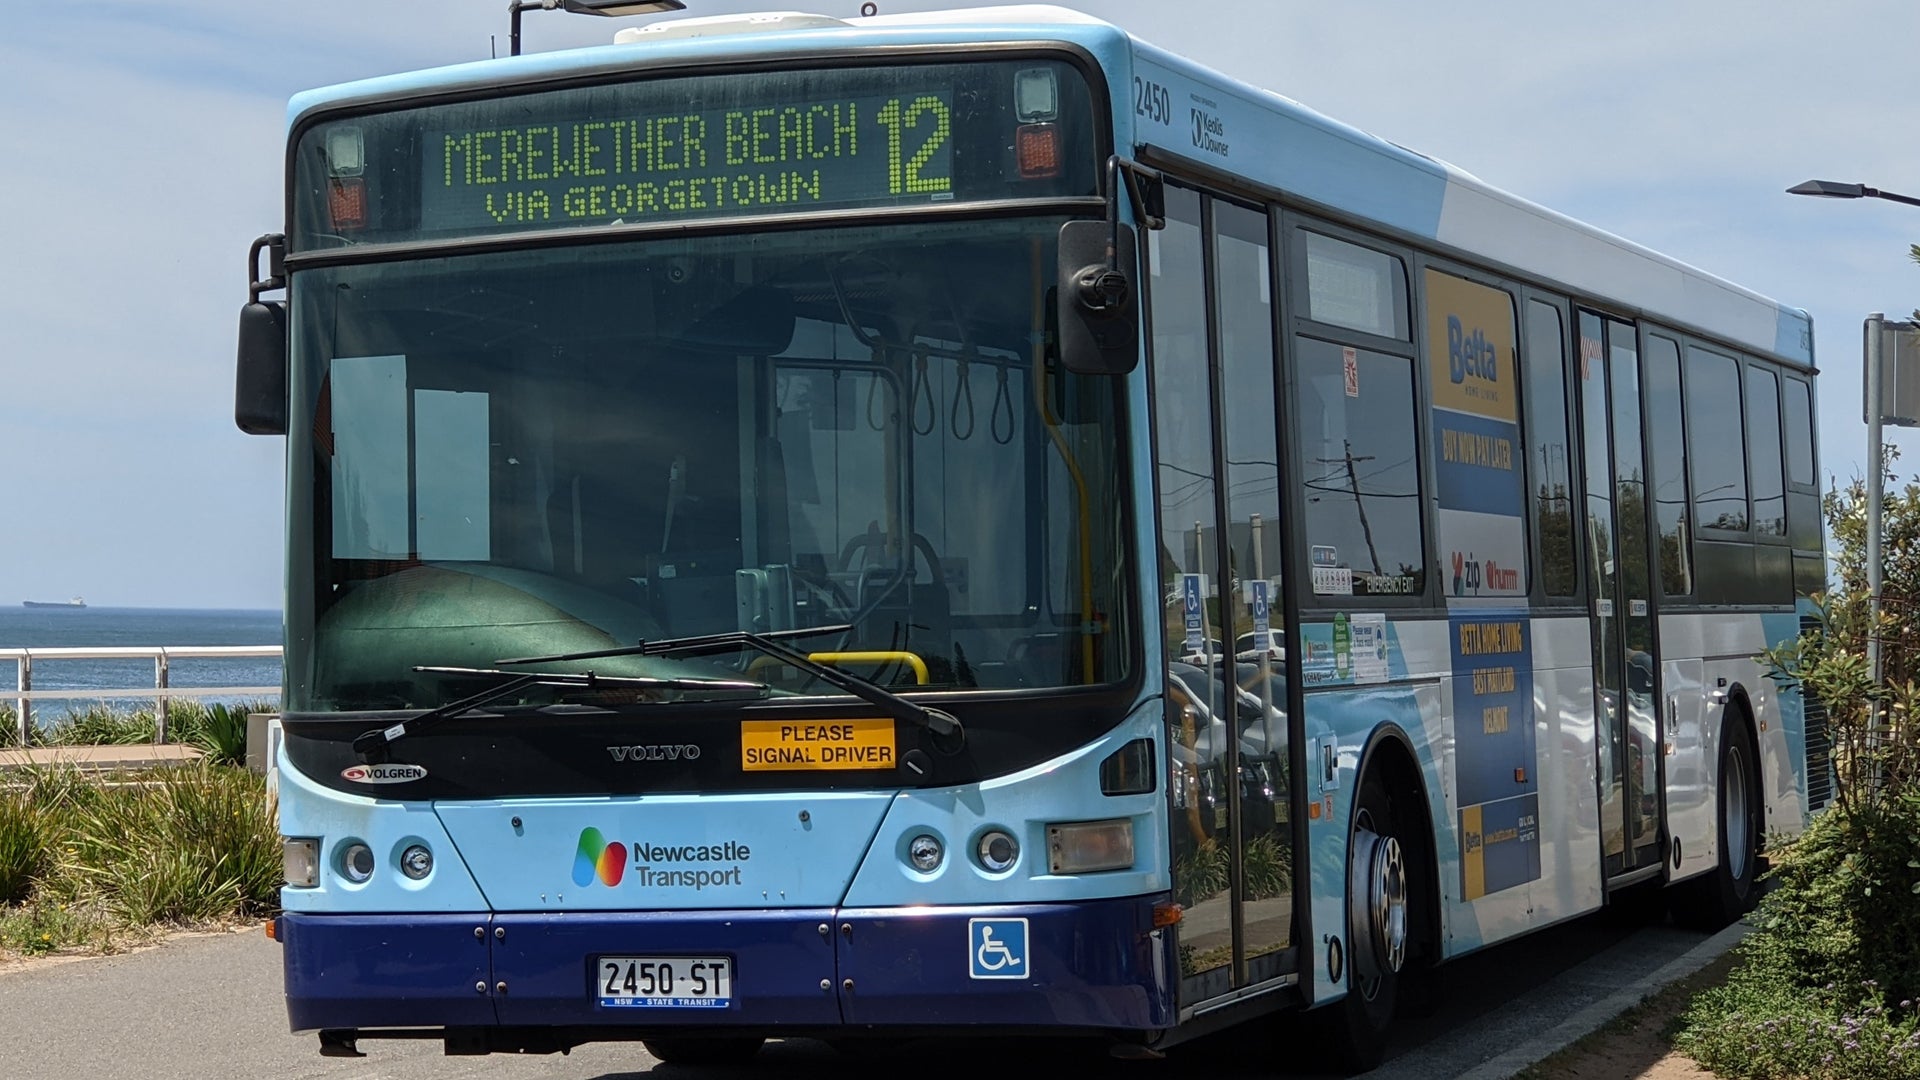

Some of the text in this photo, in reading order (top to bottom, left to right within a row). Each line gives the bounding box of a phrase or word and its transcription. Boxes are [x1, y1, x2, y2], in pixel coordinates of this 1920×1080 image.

[1135, 76, 1170, 126] 2450
[1203, 112, 1223, 137] Keolis
[444, 102, 857, 186] MEREWETHER BEACH
[877, 96, 951, 194] 12
[1204, 133, 1229, 157] Downer
[486, 170, 820, 222] VIA GEORGETOWN
[1447, 314, 1497, 384] Betta
[1442, 428, 1512, 470] BUY NOW PAY LATER
[1367, 576, 1402, 593] EMERGENCY
[1402, 577, 1414, 593] EXIT
[1465, 552, 1480, 596] zip
[1460, 622, 1522, 655] BETTA HOME LIVING
[1473, 668, 1487, 695] EAST
[781, 725, 854, 742] PLEASE
[607, 744, 701, 761] VOLVO
[746, 746, 892, 764] SIGNAL DRIVER
[366, 768, 422, 779] VOLGREN
[634, 840, 750, 862] Newcastle
[635, 865, 742, 891] Transport
[647, 998, 674, 1006] STATE
[678, 998, 717, 1006] TRANSIT
